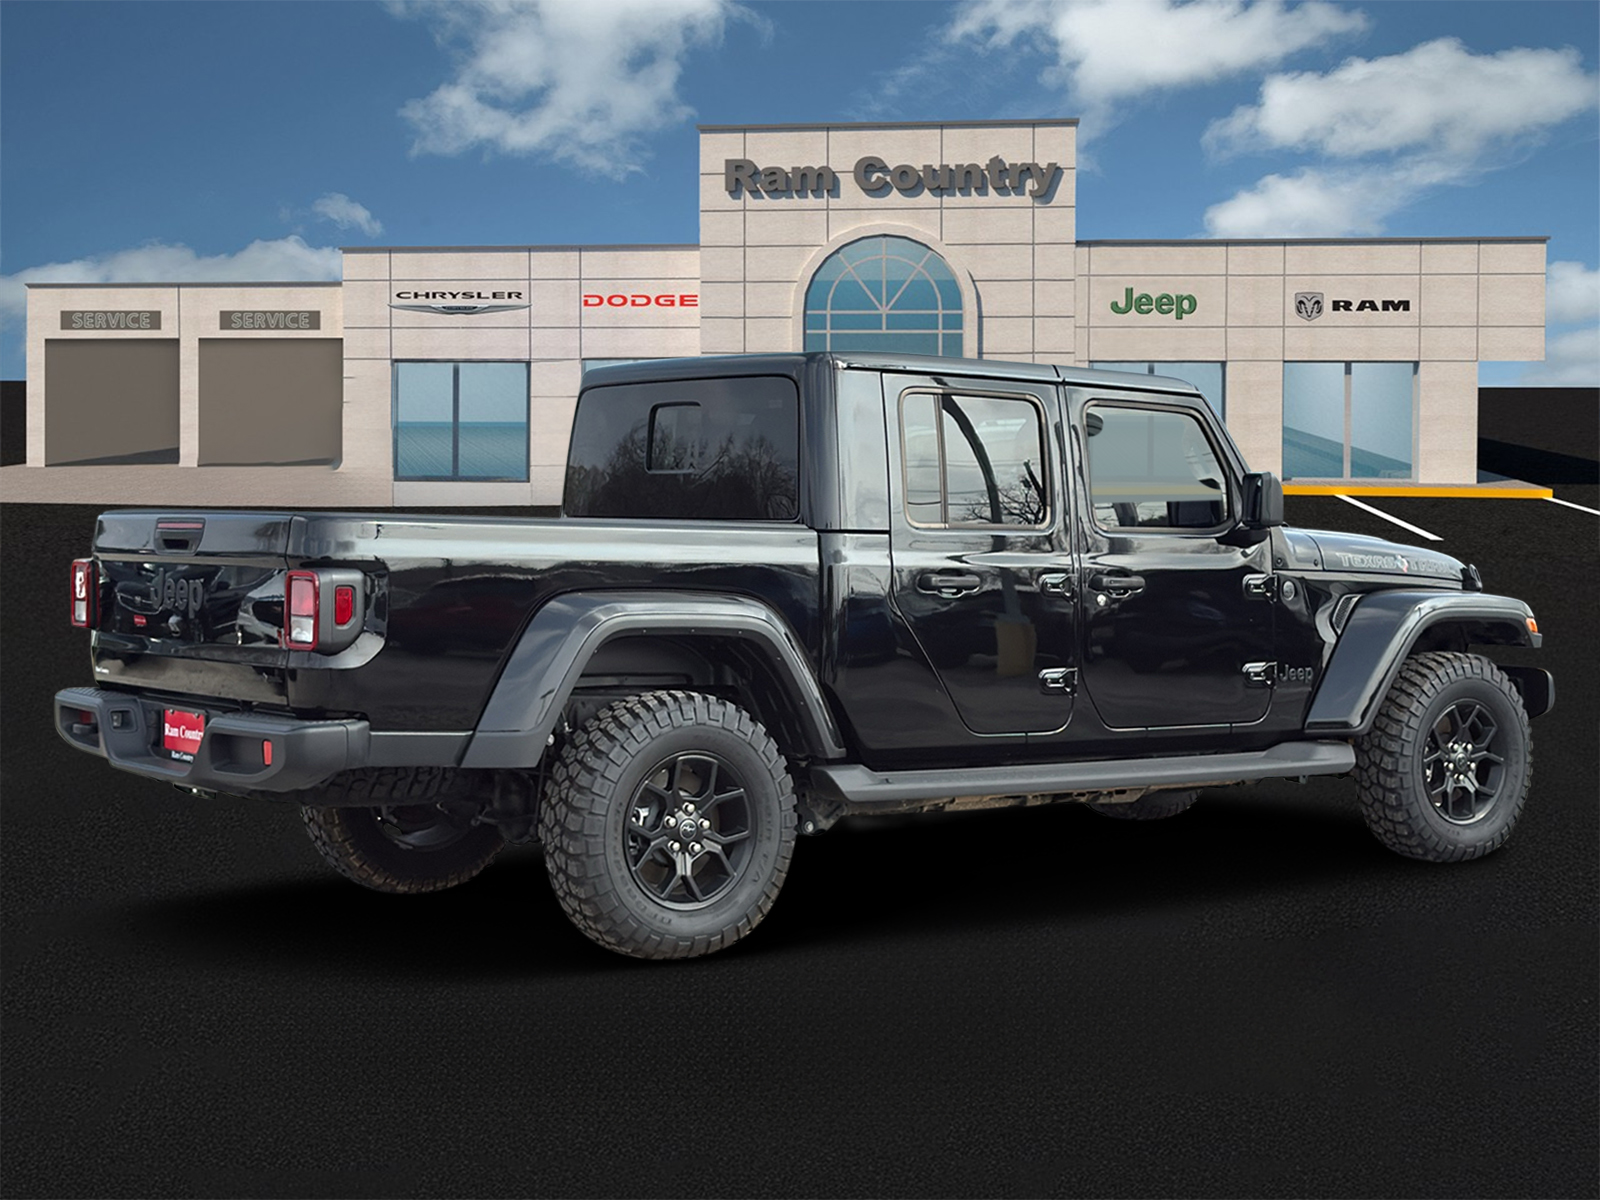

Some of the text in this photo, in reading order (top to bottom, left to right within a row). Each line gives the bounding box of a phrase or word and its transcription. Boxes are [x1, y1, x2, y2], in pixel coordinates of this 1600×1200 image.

[724, 154, 1059, 197] Ram Country
[395, 291, 523, 300] CHRYSLER
[583, 294, 699, 307] DODGE
[1110, 286, 1197, 320] Jeep
[1332, 299, 1410, 312] RAM
[71, 312, 151, 329] SERVICE
[230, 312, 310, 329] SERVICE
[1335, 552, 1397, 570] TEXAS
[150, 567, 204, 619] Jeep
[1279, 663, 1314, 684] Jeep
[164, 722, 179, 738] Ram
